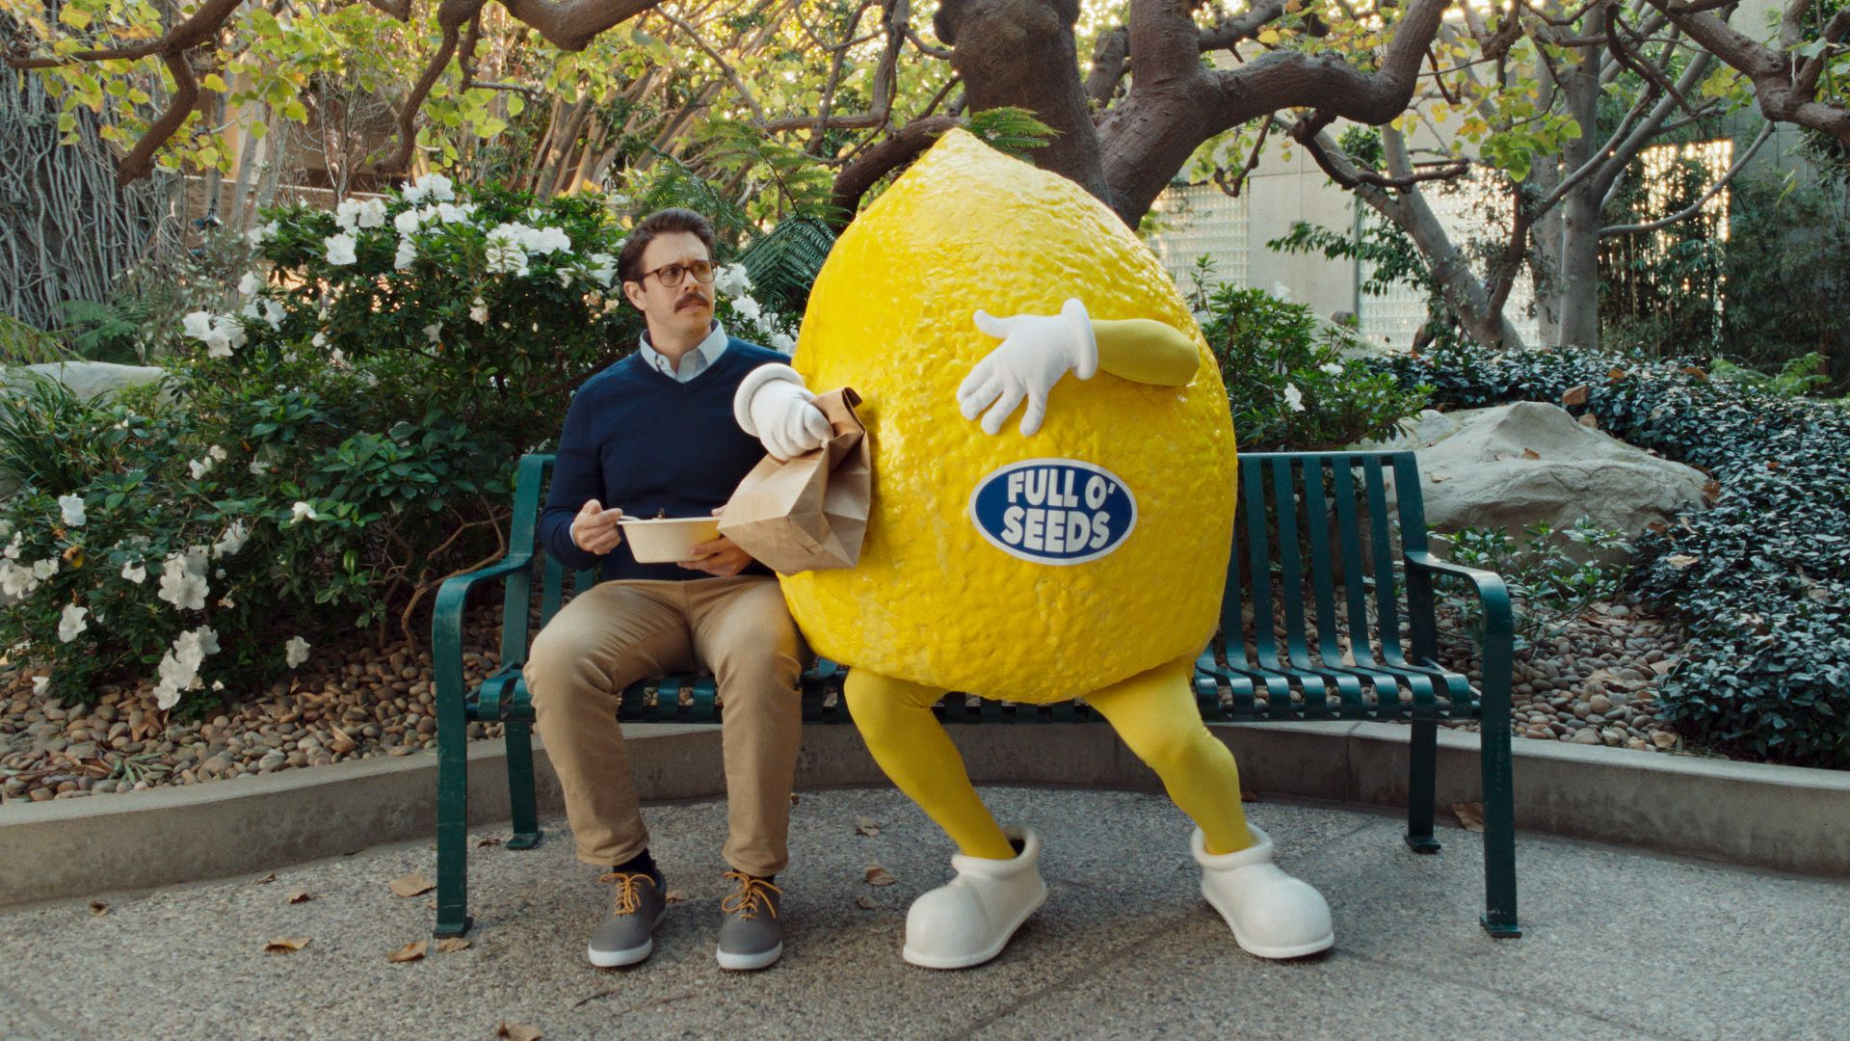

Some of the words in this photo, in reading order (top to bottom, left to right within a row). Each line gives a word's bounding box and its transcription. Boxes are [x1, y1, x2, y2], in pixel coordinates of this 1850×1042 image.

[1007, 468, 1079, 508] FULL
[1085, 475, 1116, 510] O'
[1000, 505, 1110, 553] SEEDS
